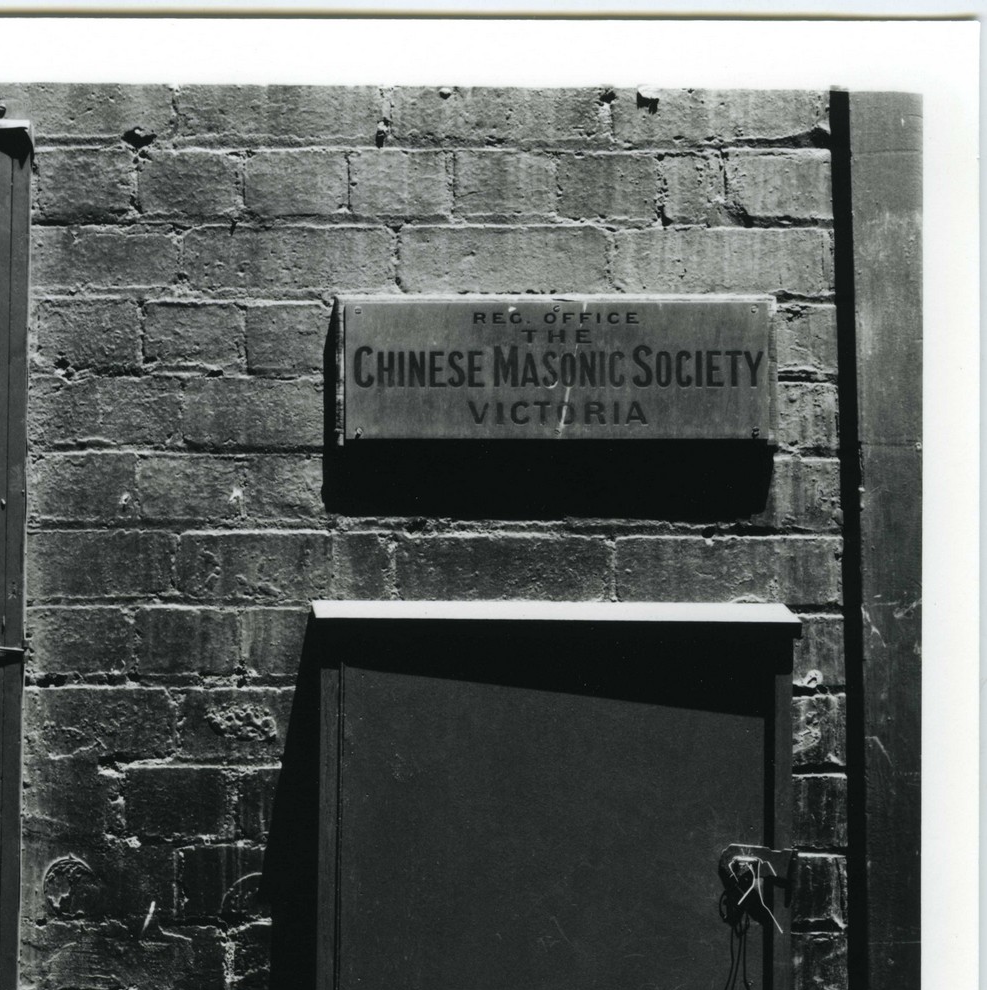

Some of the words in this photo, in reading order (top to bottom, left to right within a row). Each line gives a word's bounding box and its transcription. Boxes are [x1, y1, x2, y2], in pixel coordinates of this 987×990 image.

[473, 312, 532, 325] REG.
[544, 312, 639, 325] OFFICE
[521, 329, 592, 343] THE
[353, 345, 485, 389] CHINESE
[494, 346, 625, 388] MASONIC
[632, 345, 764, 388] SOCIETY
[468, 401, 648, 426] VICTORIA
